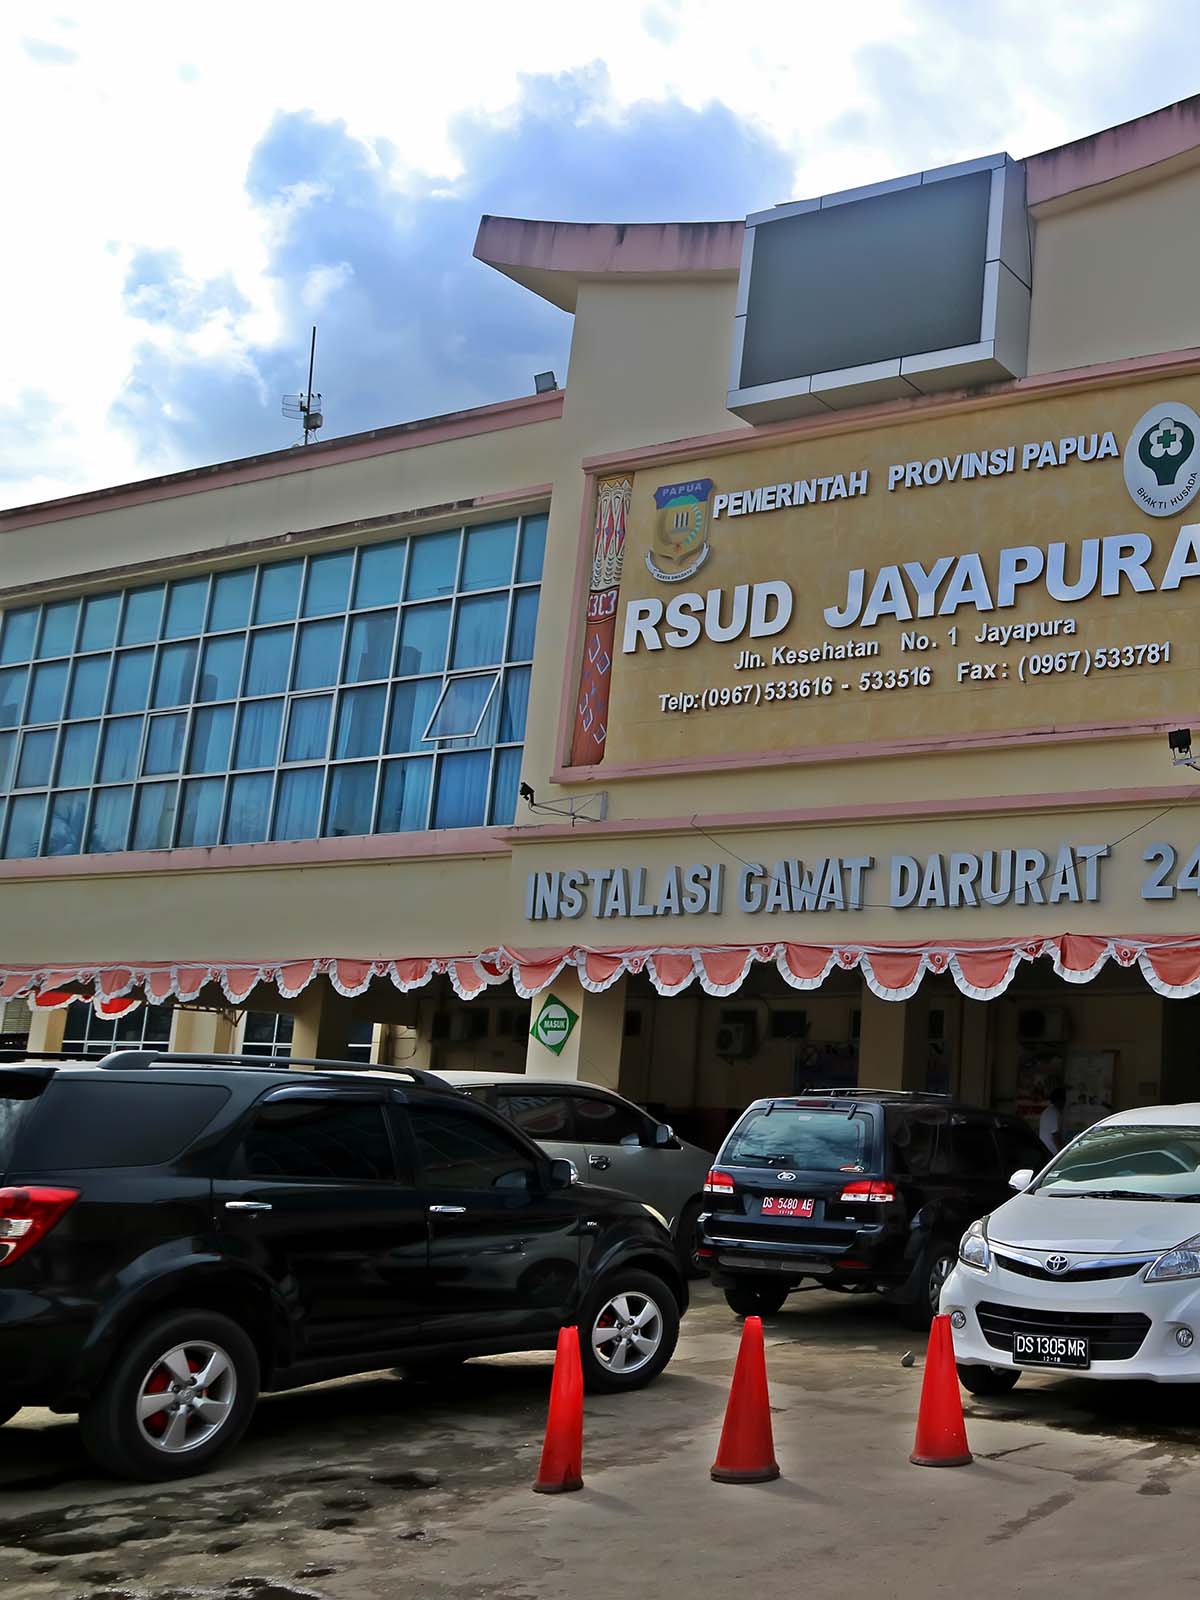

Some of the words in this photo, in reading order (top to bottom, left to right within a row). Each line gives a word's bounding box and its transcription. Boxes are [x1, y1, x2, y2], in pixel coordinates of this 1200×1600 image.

[662, 482, 703, 497] PAPUA
[712, 468, 869, 519] PEMERINTAH
[887, 445, 1015, 492] PROVINSI
[1021, 431, 1120, 471] PAPUA
[1136, 487, 1168, 509] BHAKTI
[1170, 471, 1198, 506] HUSADA
[623, 580, 794, 654] RSUD
[734, 651, 766, 670] Jln.
[772, 638, 879, 666] Kesehatan
[901, 631, 938, 652] No.
[948, 626, 958, 646] 1
[974, 616, 1077, 647] Jayapura
[858, 664, 933, 692] 533516
[1018, 641, 1172, 683] (0967)533781
[526, 863, 725, 920] INSTALASI
[738, 855, 875, 914] GAWAT
[889, 843, 1112, 908] DARURAT
[544, 1020, 565, 1029] MASUK
[762, 1196, 774, 1208] DS
[777, 1197, 798, 1210] 5480
[801, 1199, 813, 1210] AE
[1016, 1335, 1034, 1353] DS
[1036, 1337, 1066, 1356] 1305
[1067, 1339, 1086, 1357] MR
